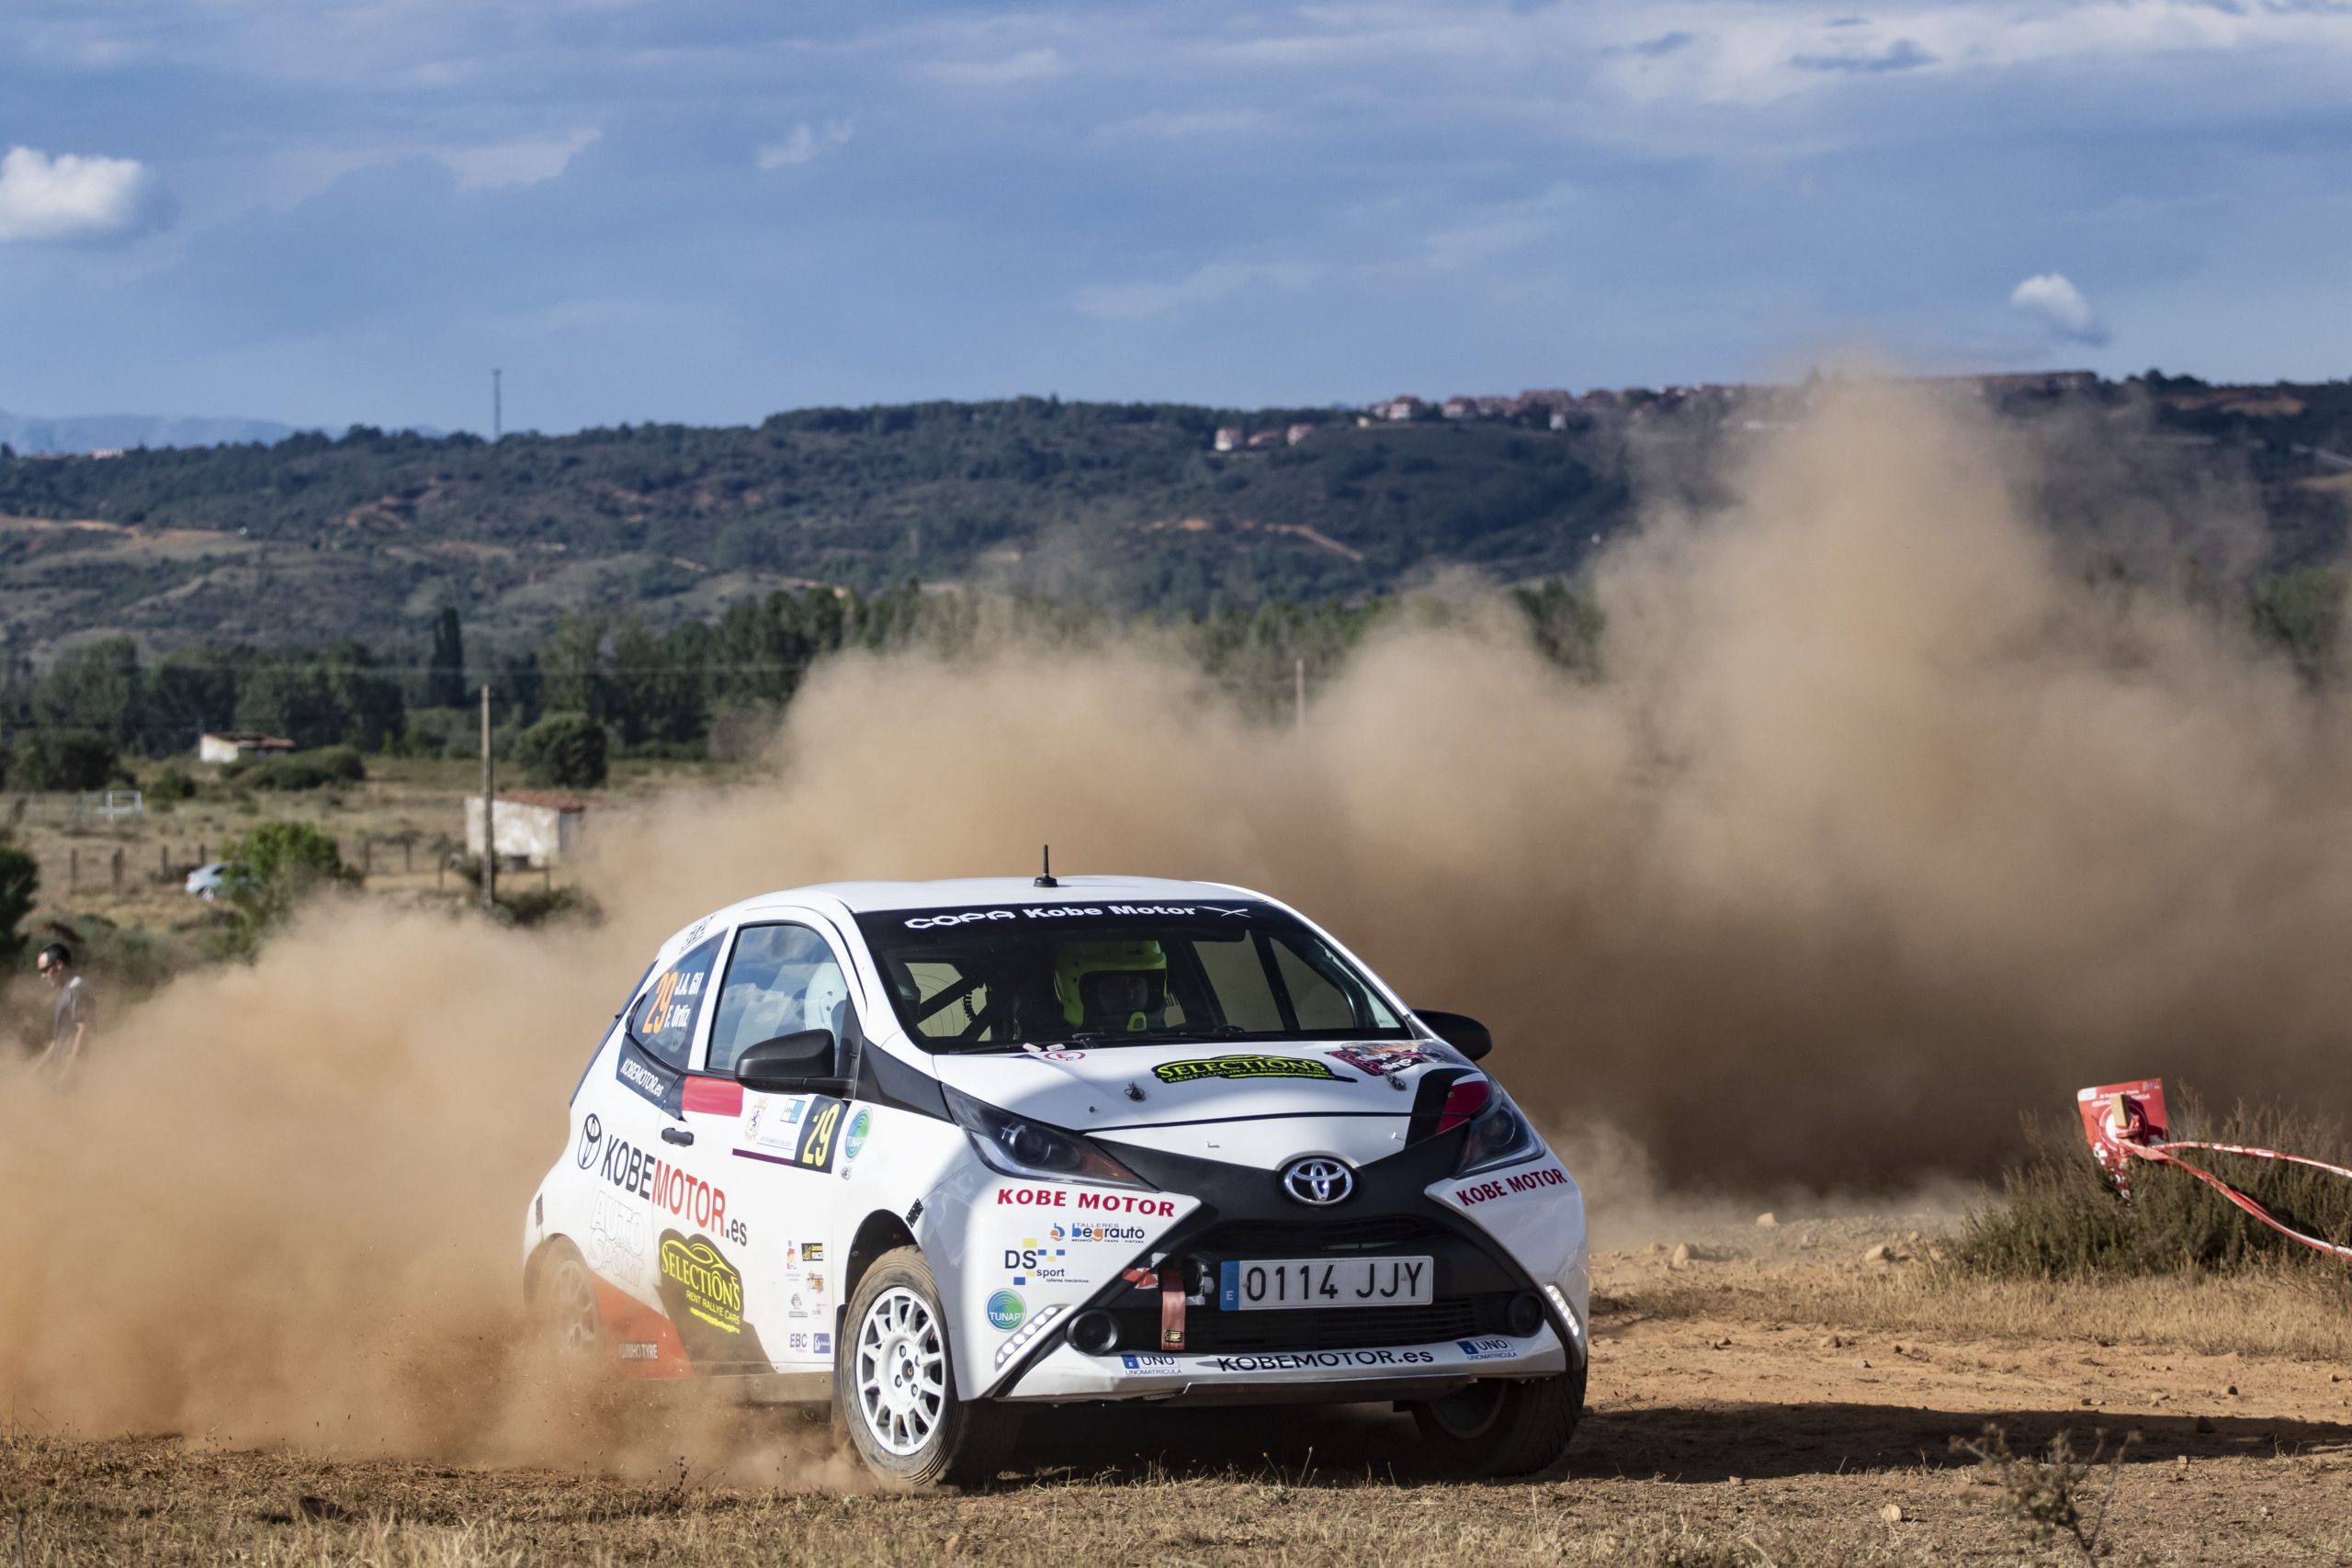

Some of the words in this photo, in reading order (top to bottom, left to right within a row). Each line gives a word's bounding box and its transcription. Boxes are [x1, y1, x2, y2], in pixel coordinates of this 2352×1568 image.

[904, 909, 1016, 929] COPA
[1022, 906, 1103, 919] Kobe
[1107, 905, 1195, 916] Motor
[642, 971, 679, 1033] 29
[672, 1004, 692, 1028] Ortiz
[619, 1057, 664, 1098] KOBEMOTOR.es
[1158, 1060, 1325, 1078] SELECTIONS
[1168, 1074, 1199, 1082] RENT
[802, 1103, 841, 1167] 29
[600, 1134, 747, 1247] KOBEMOTOR.es
[1455, 1180, 1509, 1206] KOBE
[1505, 1168, 1568, 1193] MOTOR
[997, 1189, 1067, 1207] KOBE
[1078, 1192, 1175, 1218] MOTOR
[590, 1190, 645, 1257] AUTO
[1071, 1223, 1146, 1242] begrauto
[1004, 1249, 1037, 1269] DS
[662, 1244, 741, 1312] SELECTIONS
[1036, 1269, 1065, 1279] sport
[1246, 1264, 1339, 1302] 0114
[1355, 1262, 1424, 1299] JJY
[1226, 1290, 1234, 1301] E
[685, 1290, 702, 1305] RENT
[702, 1298, 724, 1317] RALLYE
[724, 1309, 741, 1325] CARS
[989, 1311, 1022, 1322] TUNAP
[641, 1344, 659, 1359] TYRE
[789, 1333, 808, 1348] EBC
[1476, 1339, 1509, 1351] UNO
[1141, 1356, 1175, 1366] UNO
[1216, 1350, 1434, 1372] KOBEMOTOR.es
[1466, 1351, 1519, 1360] UNOMATRICULA
